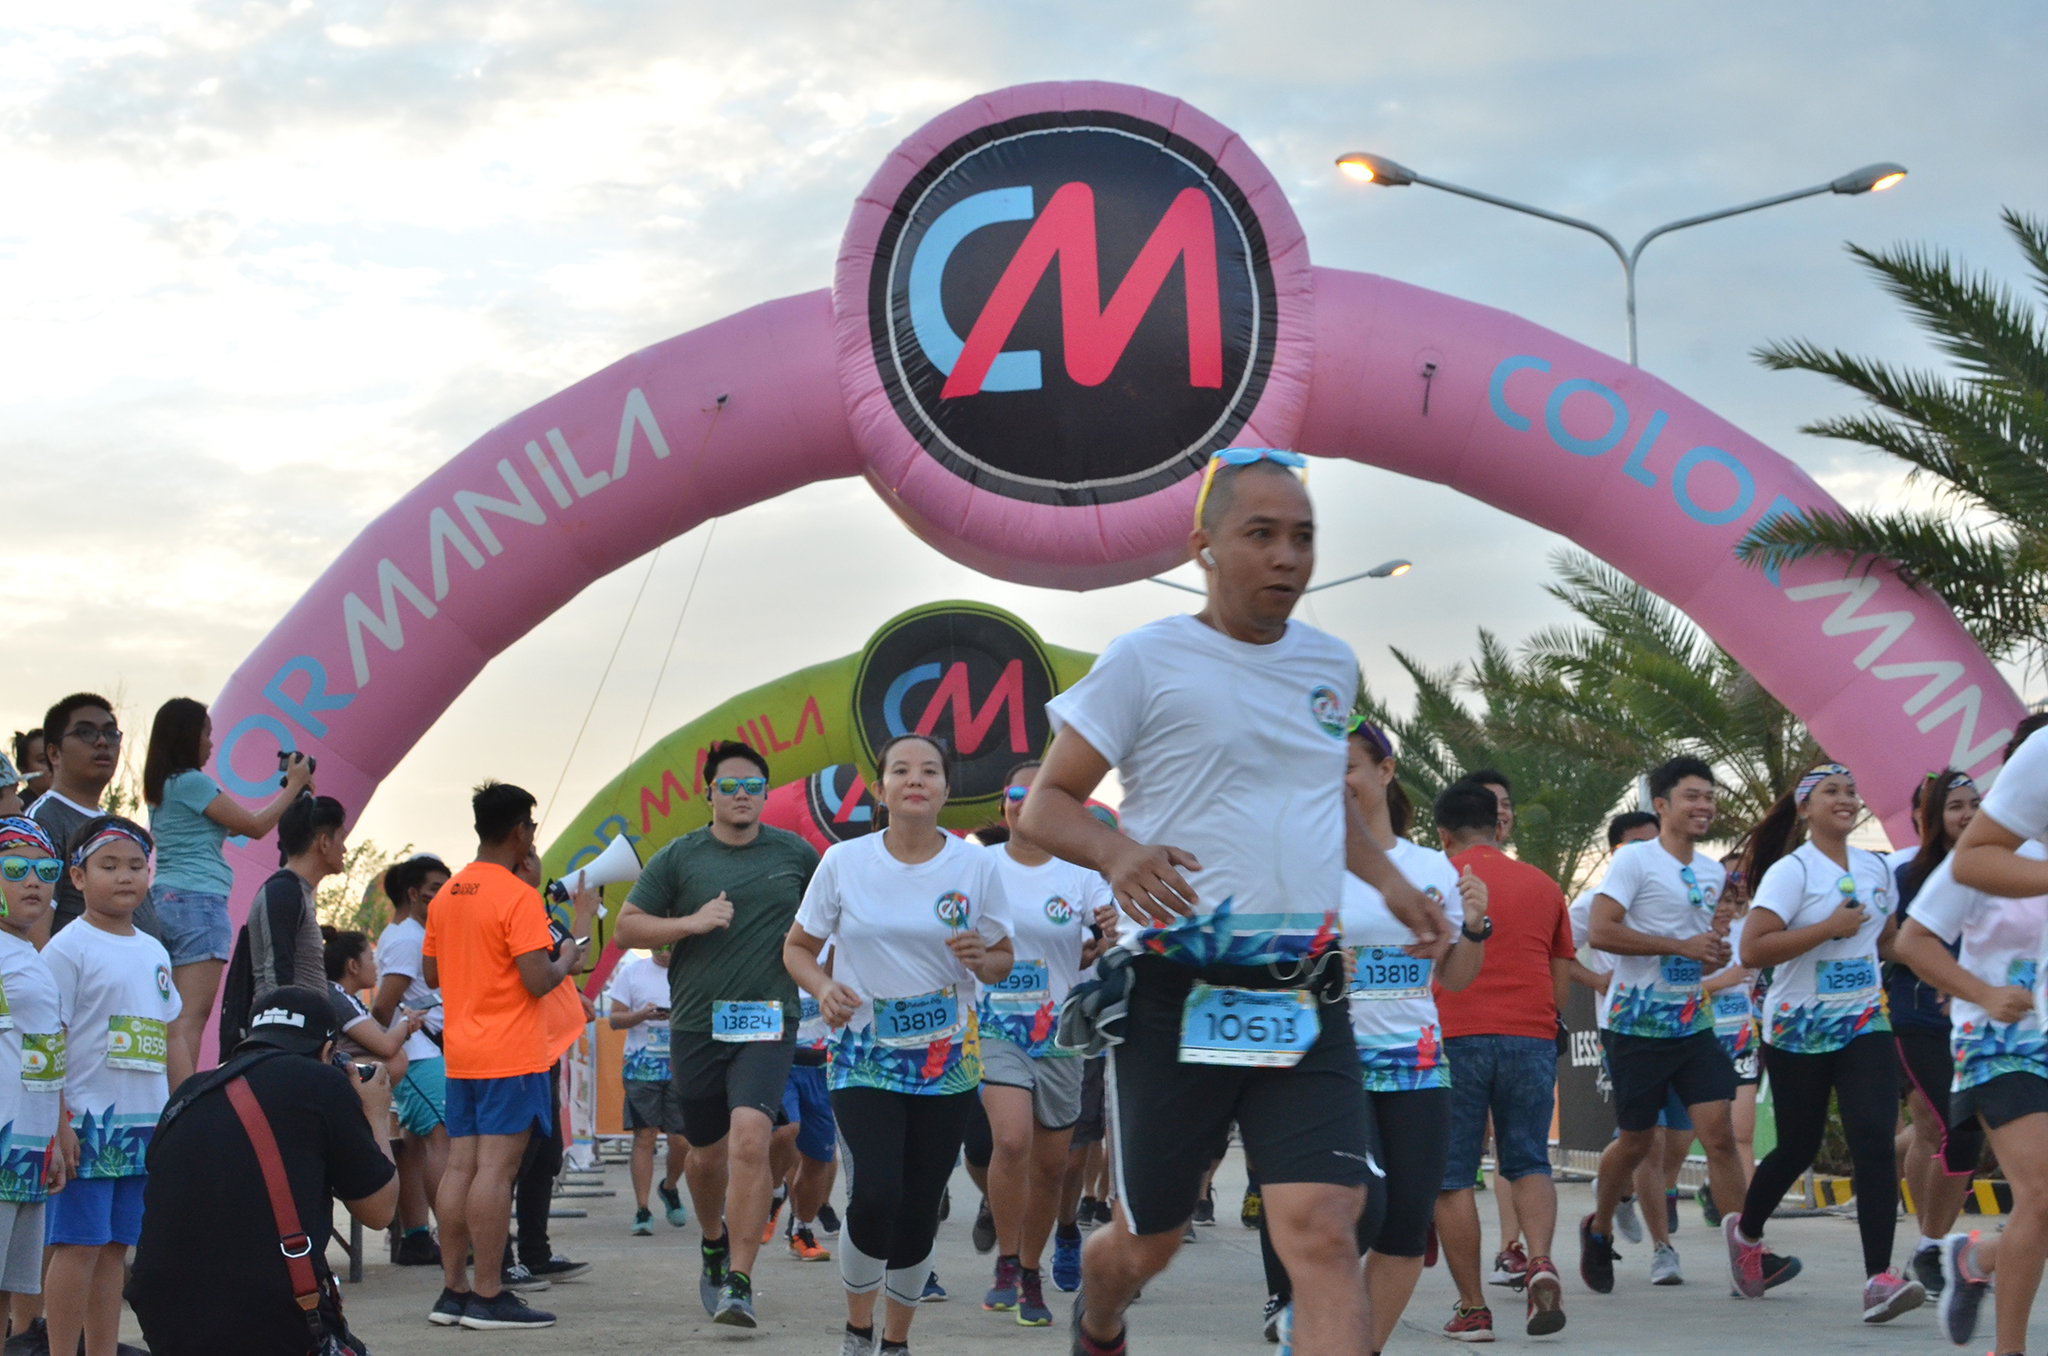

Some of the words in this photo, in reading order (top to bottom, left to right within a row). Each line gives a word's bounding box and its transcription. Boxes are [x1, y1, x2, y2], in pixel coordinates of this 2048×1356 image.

[908, 180, 1224, 400] CM
[883, 658, 1029, 756] CM
[1046, 901, 1072, 919] CM
[1366, 964, 1420, 984] 13818
[722, 1015, 773, 1030] 13824
[890, 1008, 947, 1033] 13819
[1204, 1012, 1299, 1044] 10613
[136, 1034, 167, 1056] 1859
